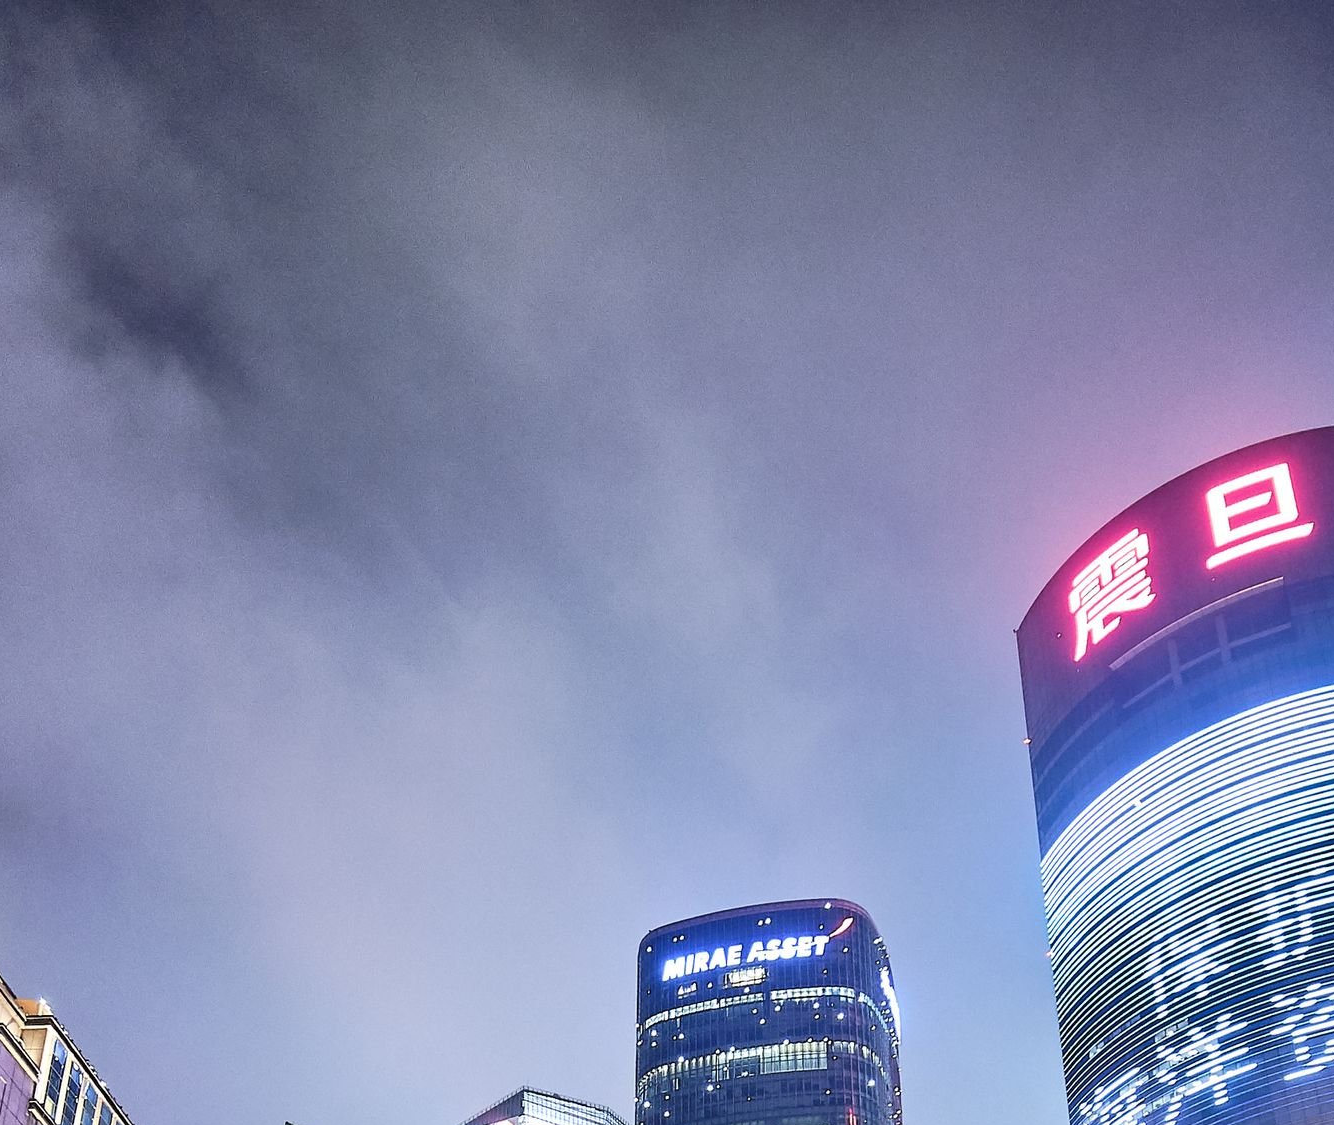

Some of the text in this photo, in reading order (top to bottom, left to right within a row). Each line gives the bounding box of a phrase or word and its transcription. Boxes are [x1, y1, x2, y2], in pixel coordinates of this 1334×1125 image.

[1068, 461, 1316, 662] 震旦
[661, 935, 830, 981] MIRAE ASSET
